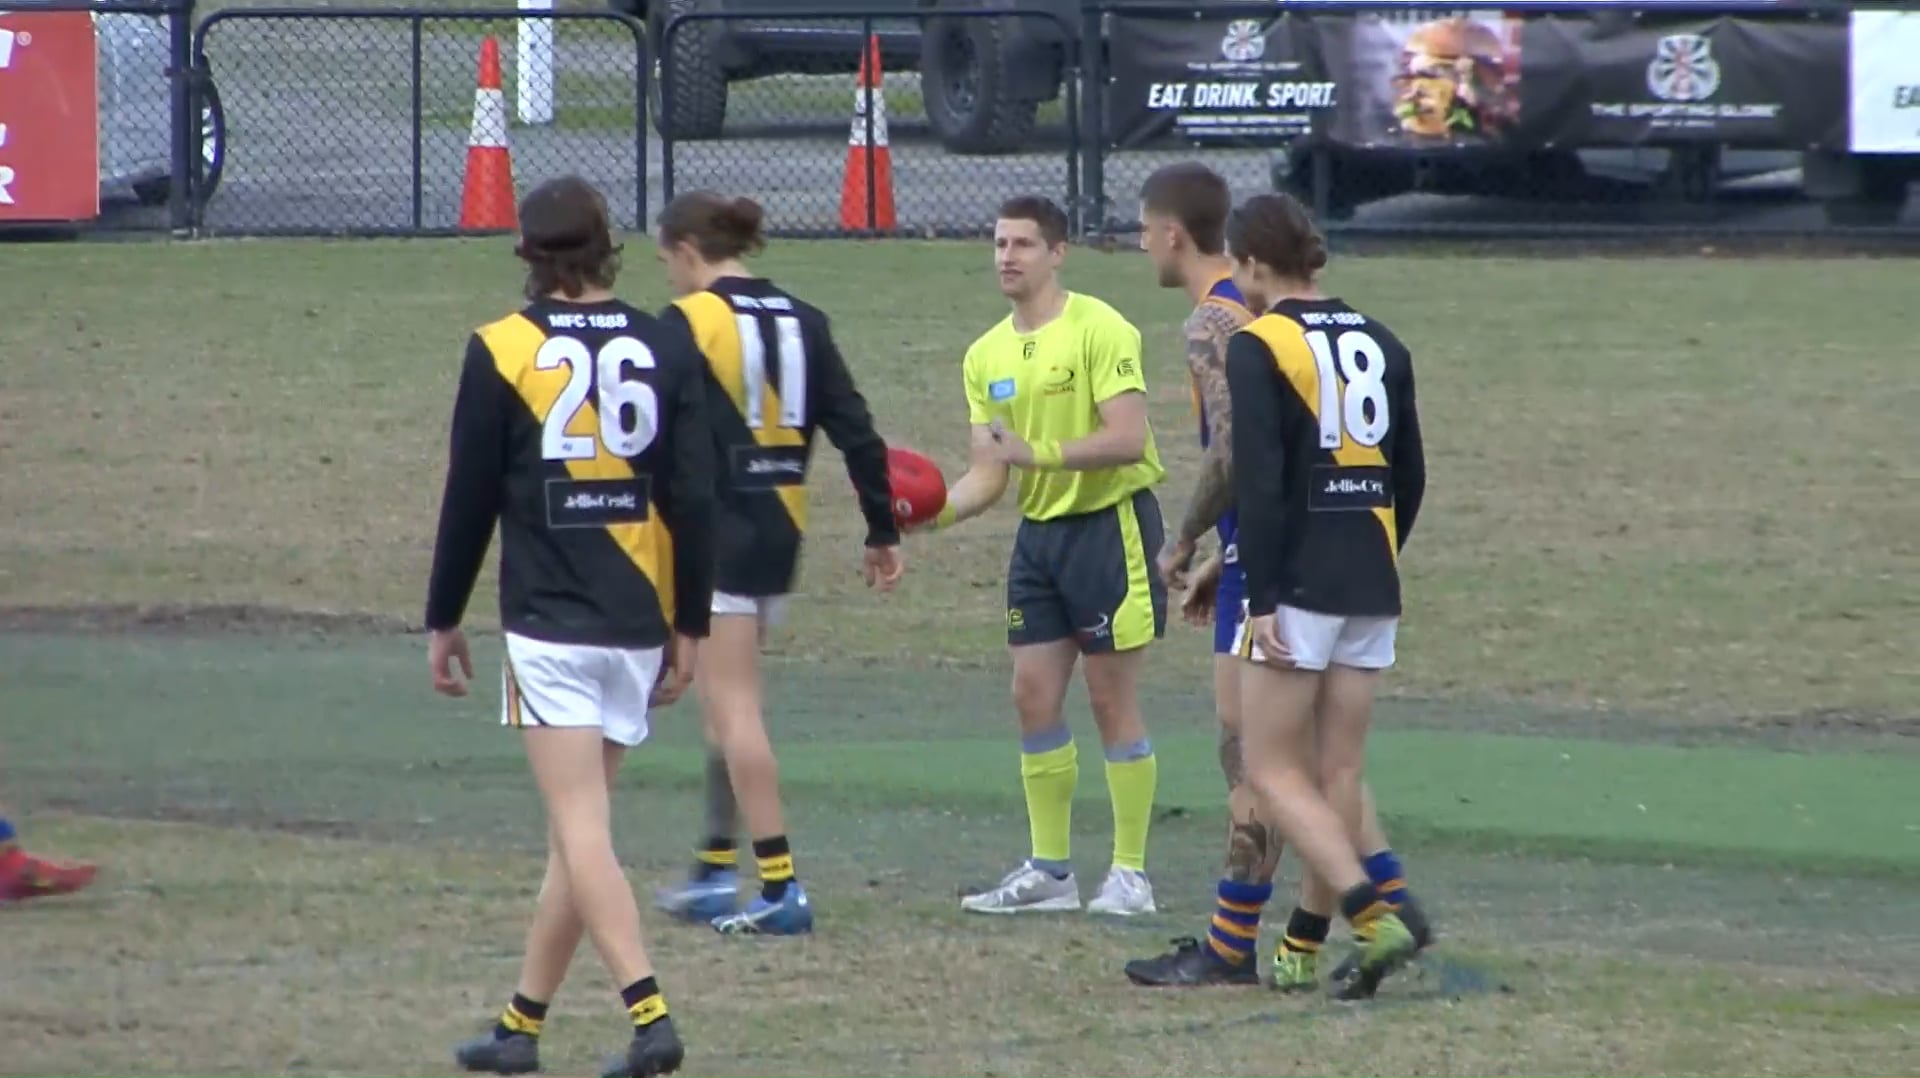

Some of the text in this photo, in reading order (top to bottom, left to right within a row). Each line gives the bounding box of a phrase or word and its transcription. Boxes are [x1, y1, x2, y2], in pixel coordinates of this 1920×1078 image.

[1147, 82, 1337, 108] EAT. DRINK. SPORT.
[548, 313, 628, 329] MFC 1888
[736, 314, 807, 427] 11
[535, 335, 659, 460] 26
[1304, 330, 1390, 449] 18
